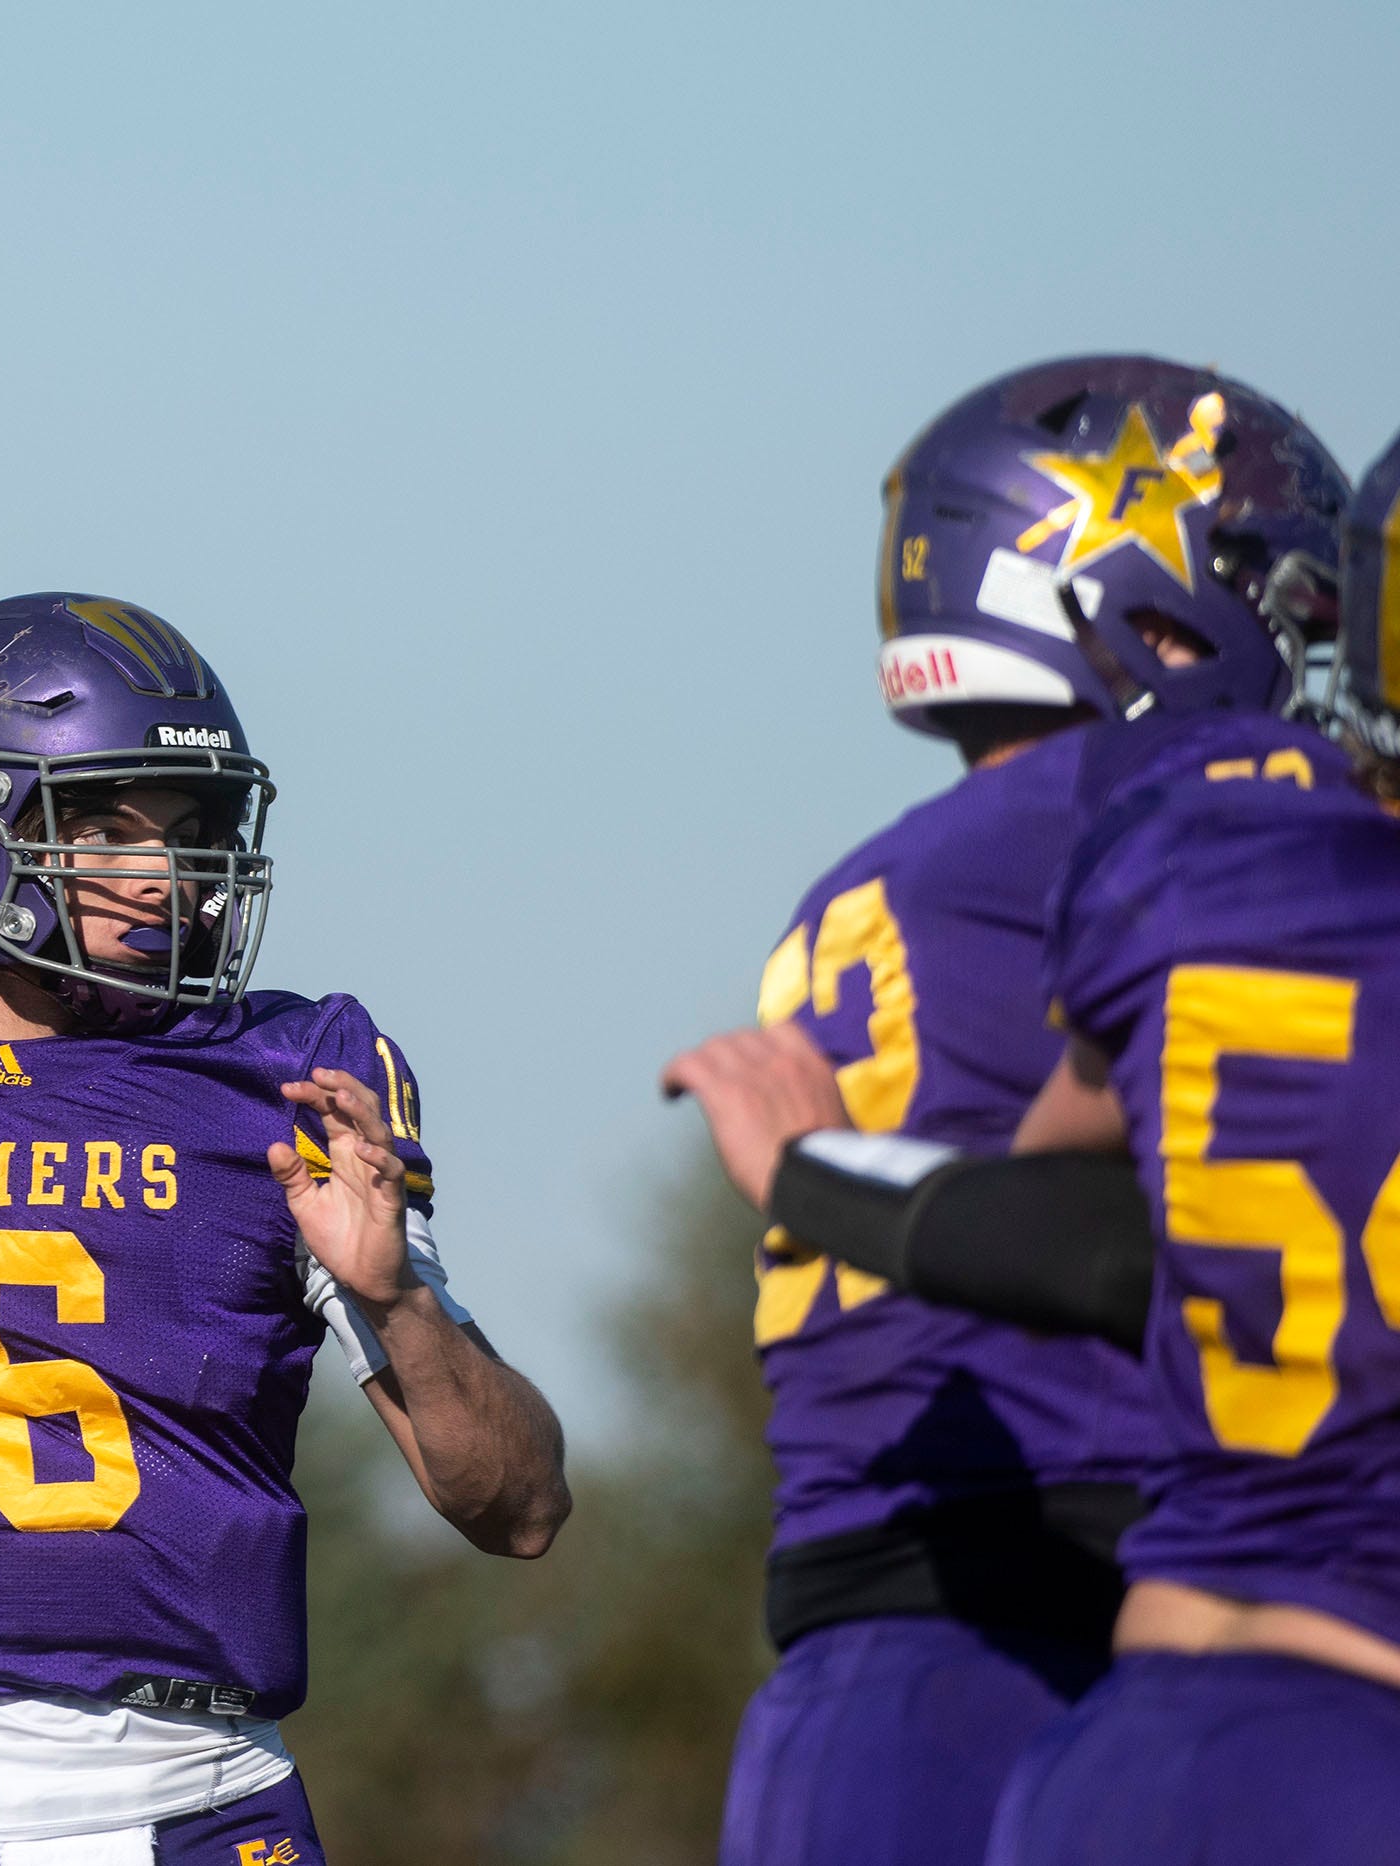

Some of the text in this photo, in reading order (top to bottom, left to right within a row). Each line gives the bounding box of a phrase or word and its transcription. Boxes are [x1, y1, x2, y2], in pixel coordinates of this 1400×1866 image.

[1107, 468, 1164, 521] F
[902, 535, 930, 582] 52
[157, 726, 232, 749] Riddell
